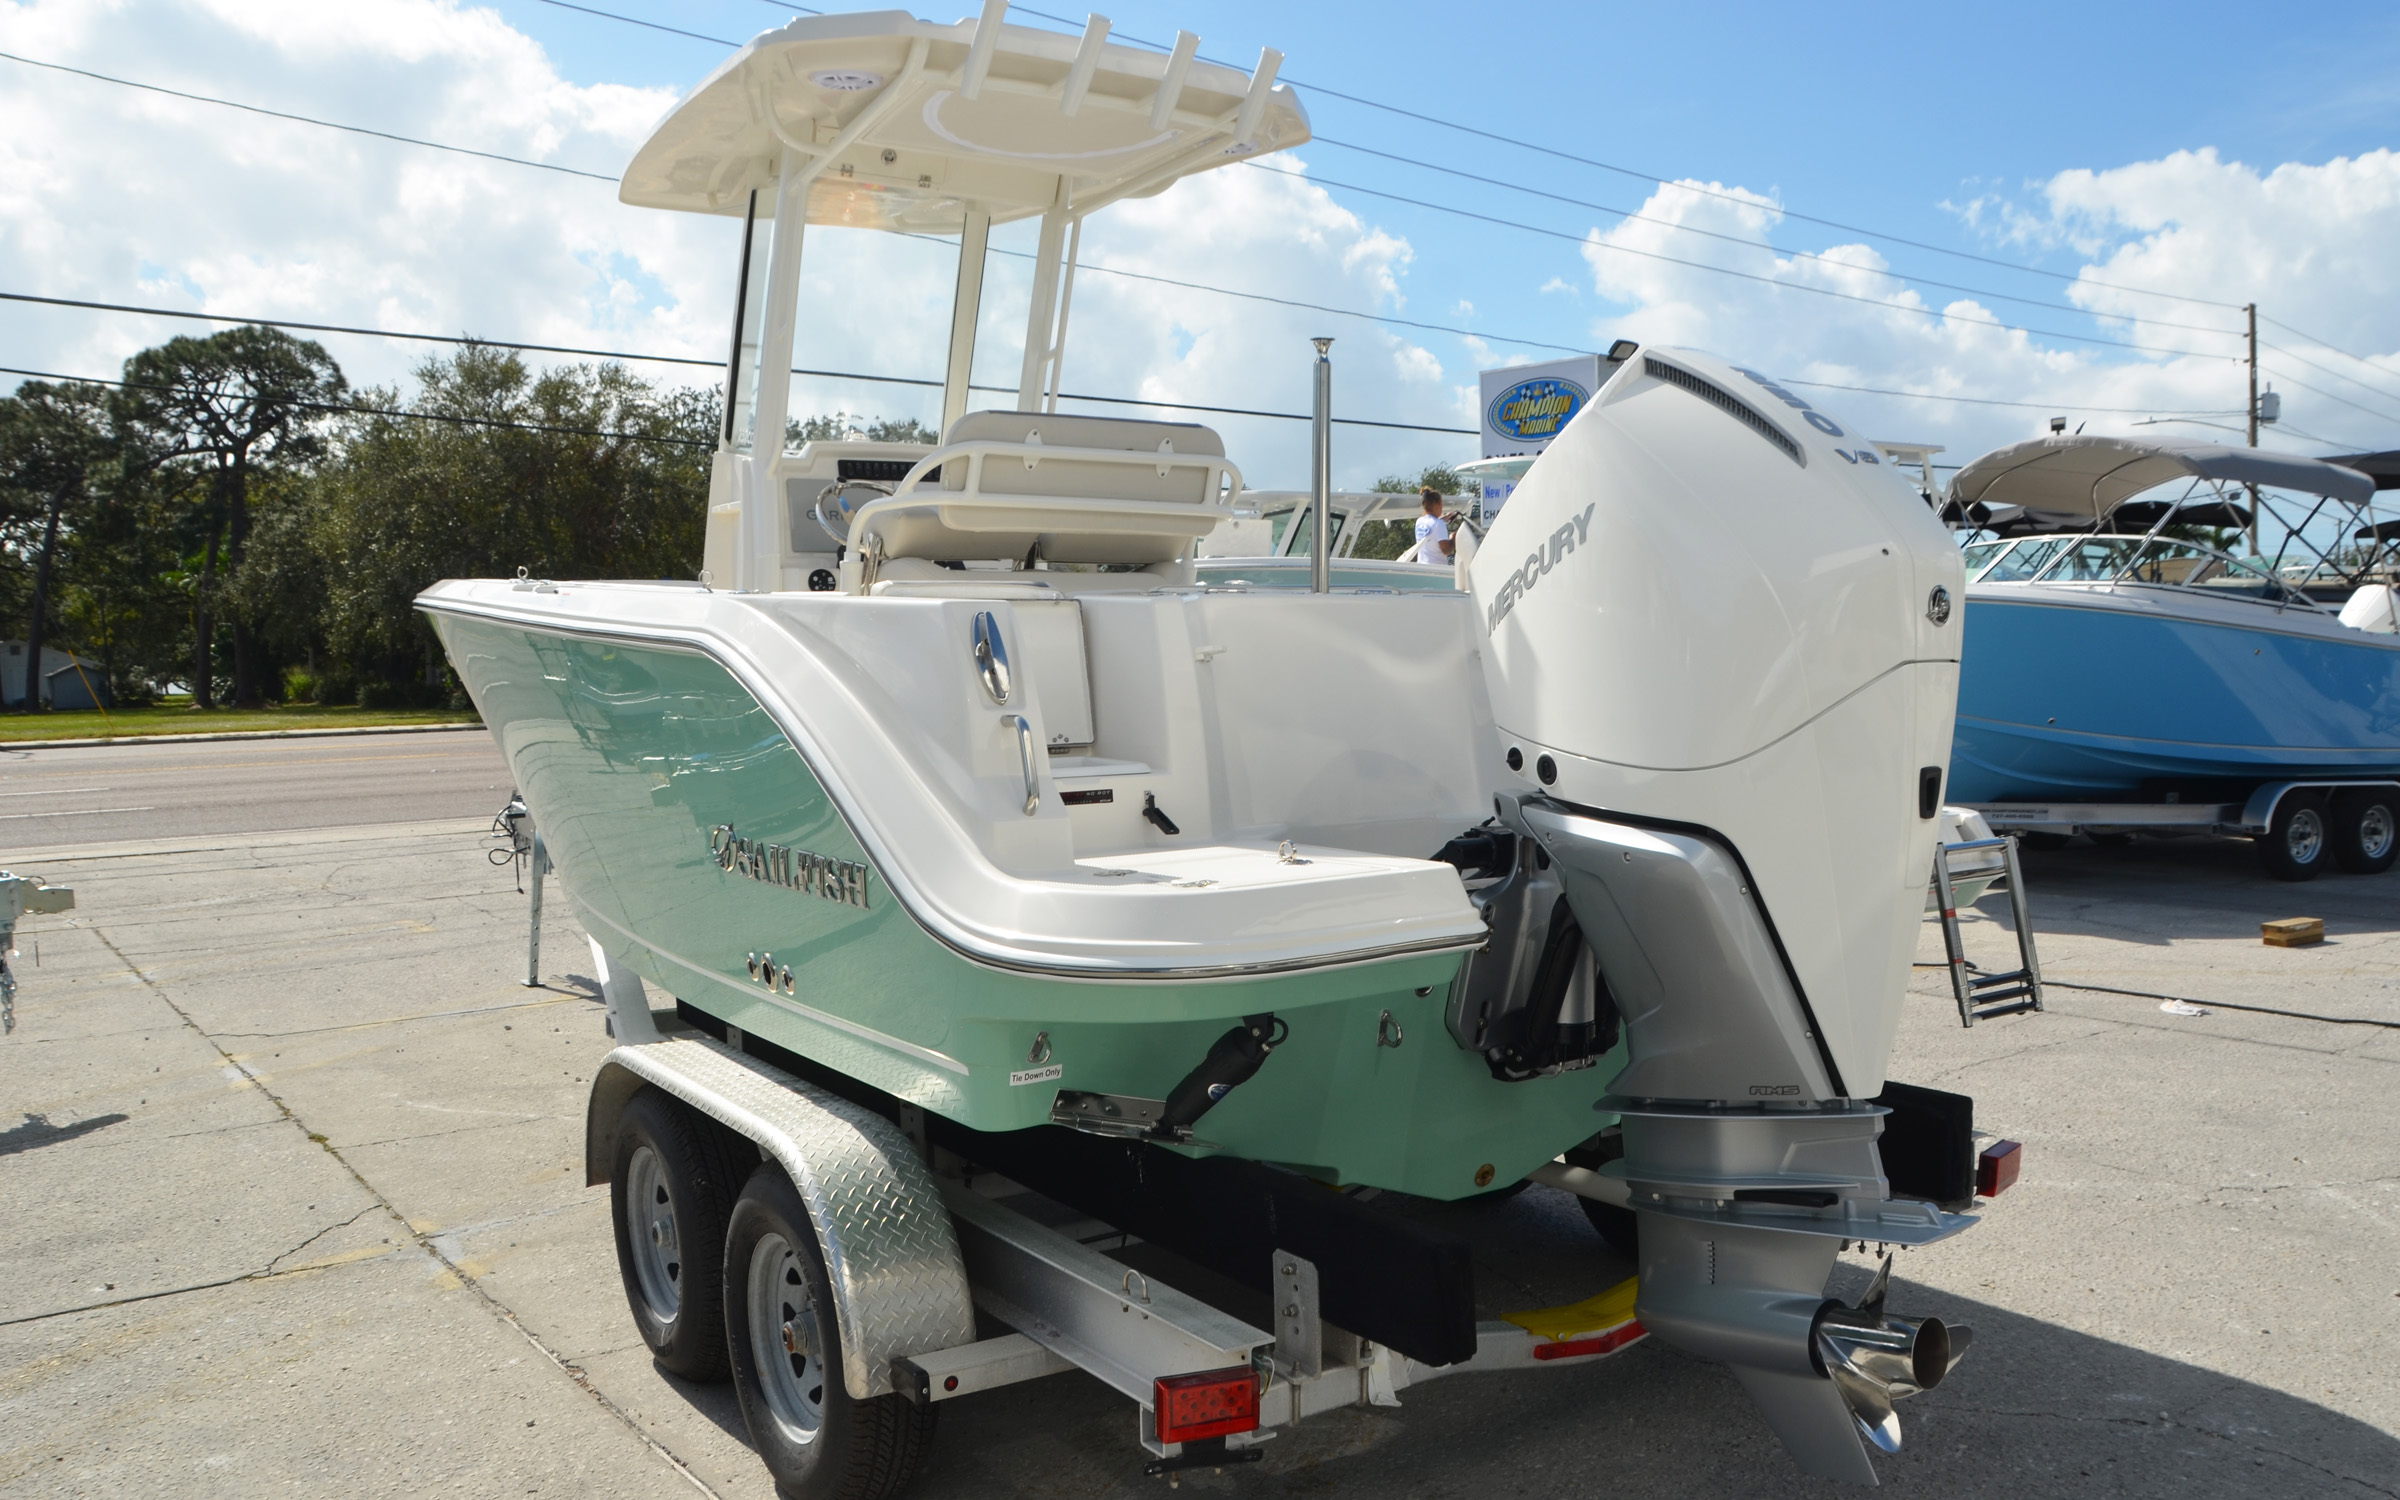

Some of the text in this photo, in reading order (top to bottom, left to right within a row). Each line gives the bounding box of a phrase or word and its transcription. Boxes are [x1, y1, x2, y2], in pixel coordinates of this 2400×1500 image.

[1502, 394, 1575, 421] CHAMPION
[1518, 417, 1561, 436] MARINE
[1485, 485, 1500, 499] New
[1487, 502, 1596, 638] MERCURY
[737, 836, 870, 911] SAILFISH
[1025, 1072, 1043, 1080] Down
[1045, 1068, 1061, 1076] Only
